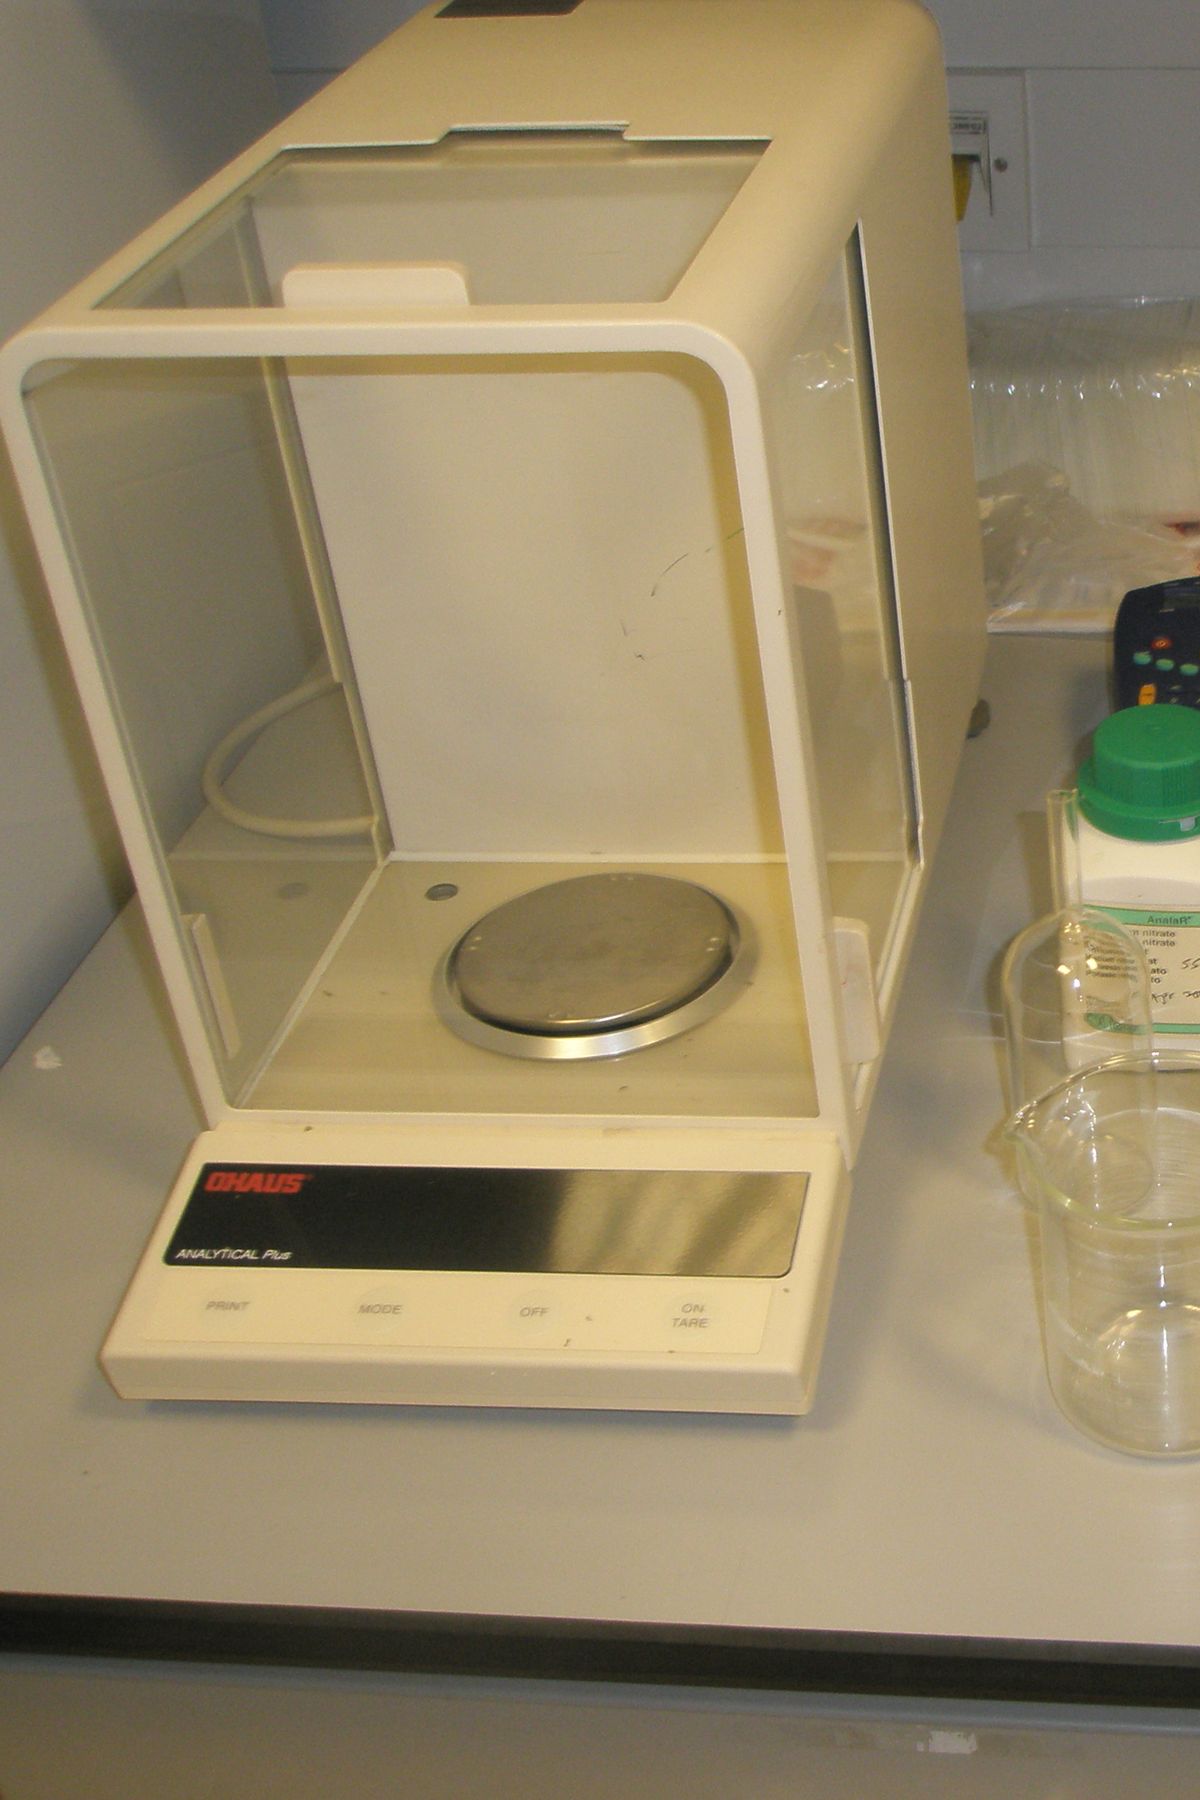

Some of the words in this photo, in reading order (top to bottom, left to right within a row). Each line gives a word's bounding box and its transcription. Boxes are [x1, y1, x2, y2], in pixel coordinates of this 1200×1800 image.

[205, 1171, 307, 1194] OHAUS
[175, 1248, 260, 1260] ANALYTICAL
[261, 1249, 293, 1261] Plus
[205, 1300, 249, 1312] PRINT
[357, 1303, 403, 1315] MODE
[519, 1306, 550, 1317] OFF
[681, 1303, 705, 1314] ON
[672, 1317, 709, 1328] TARE
